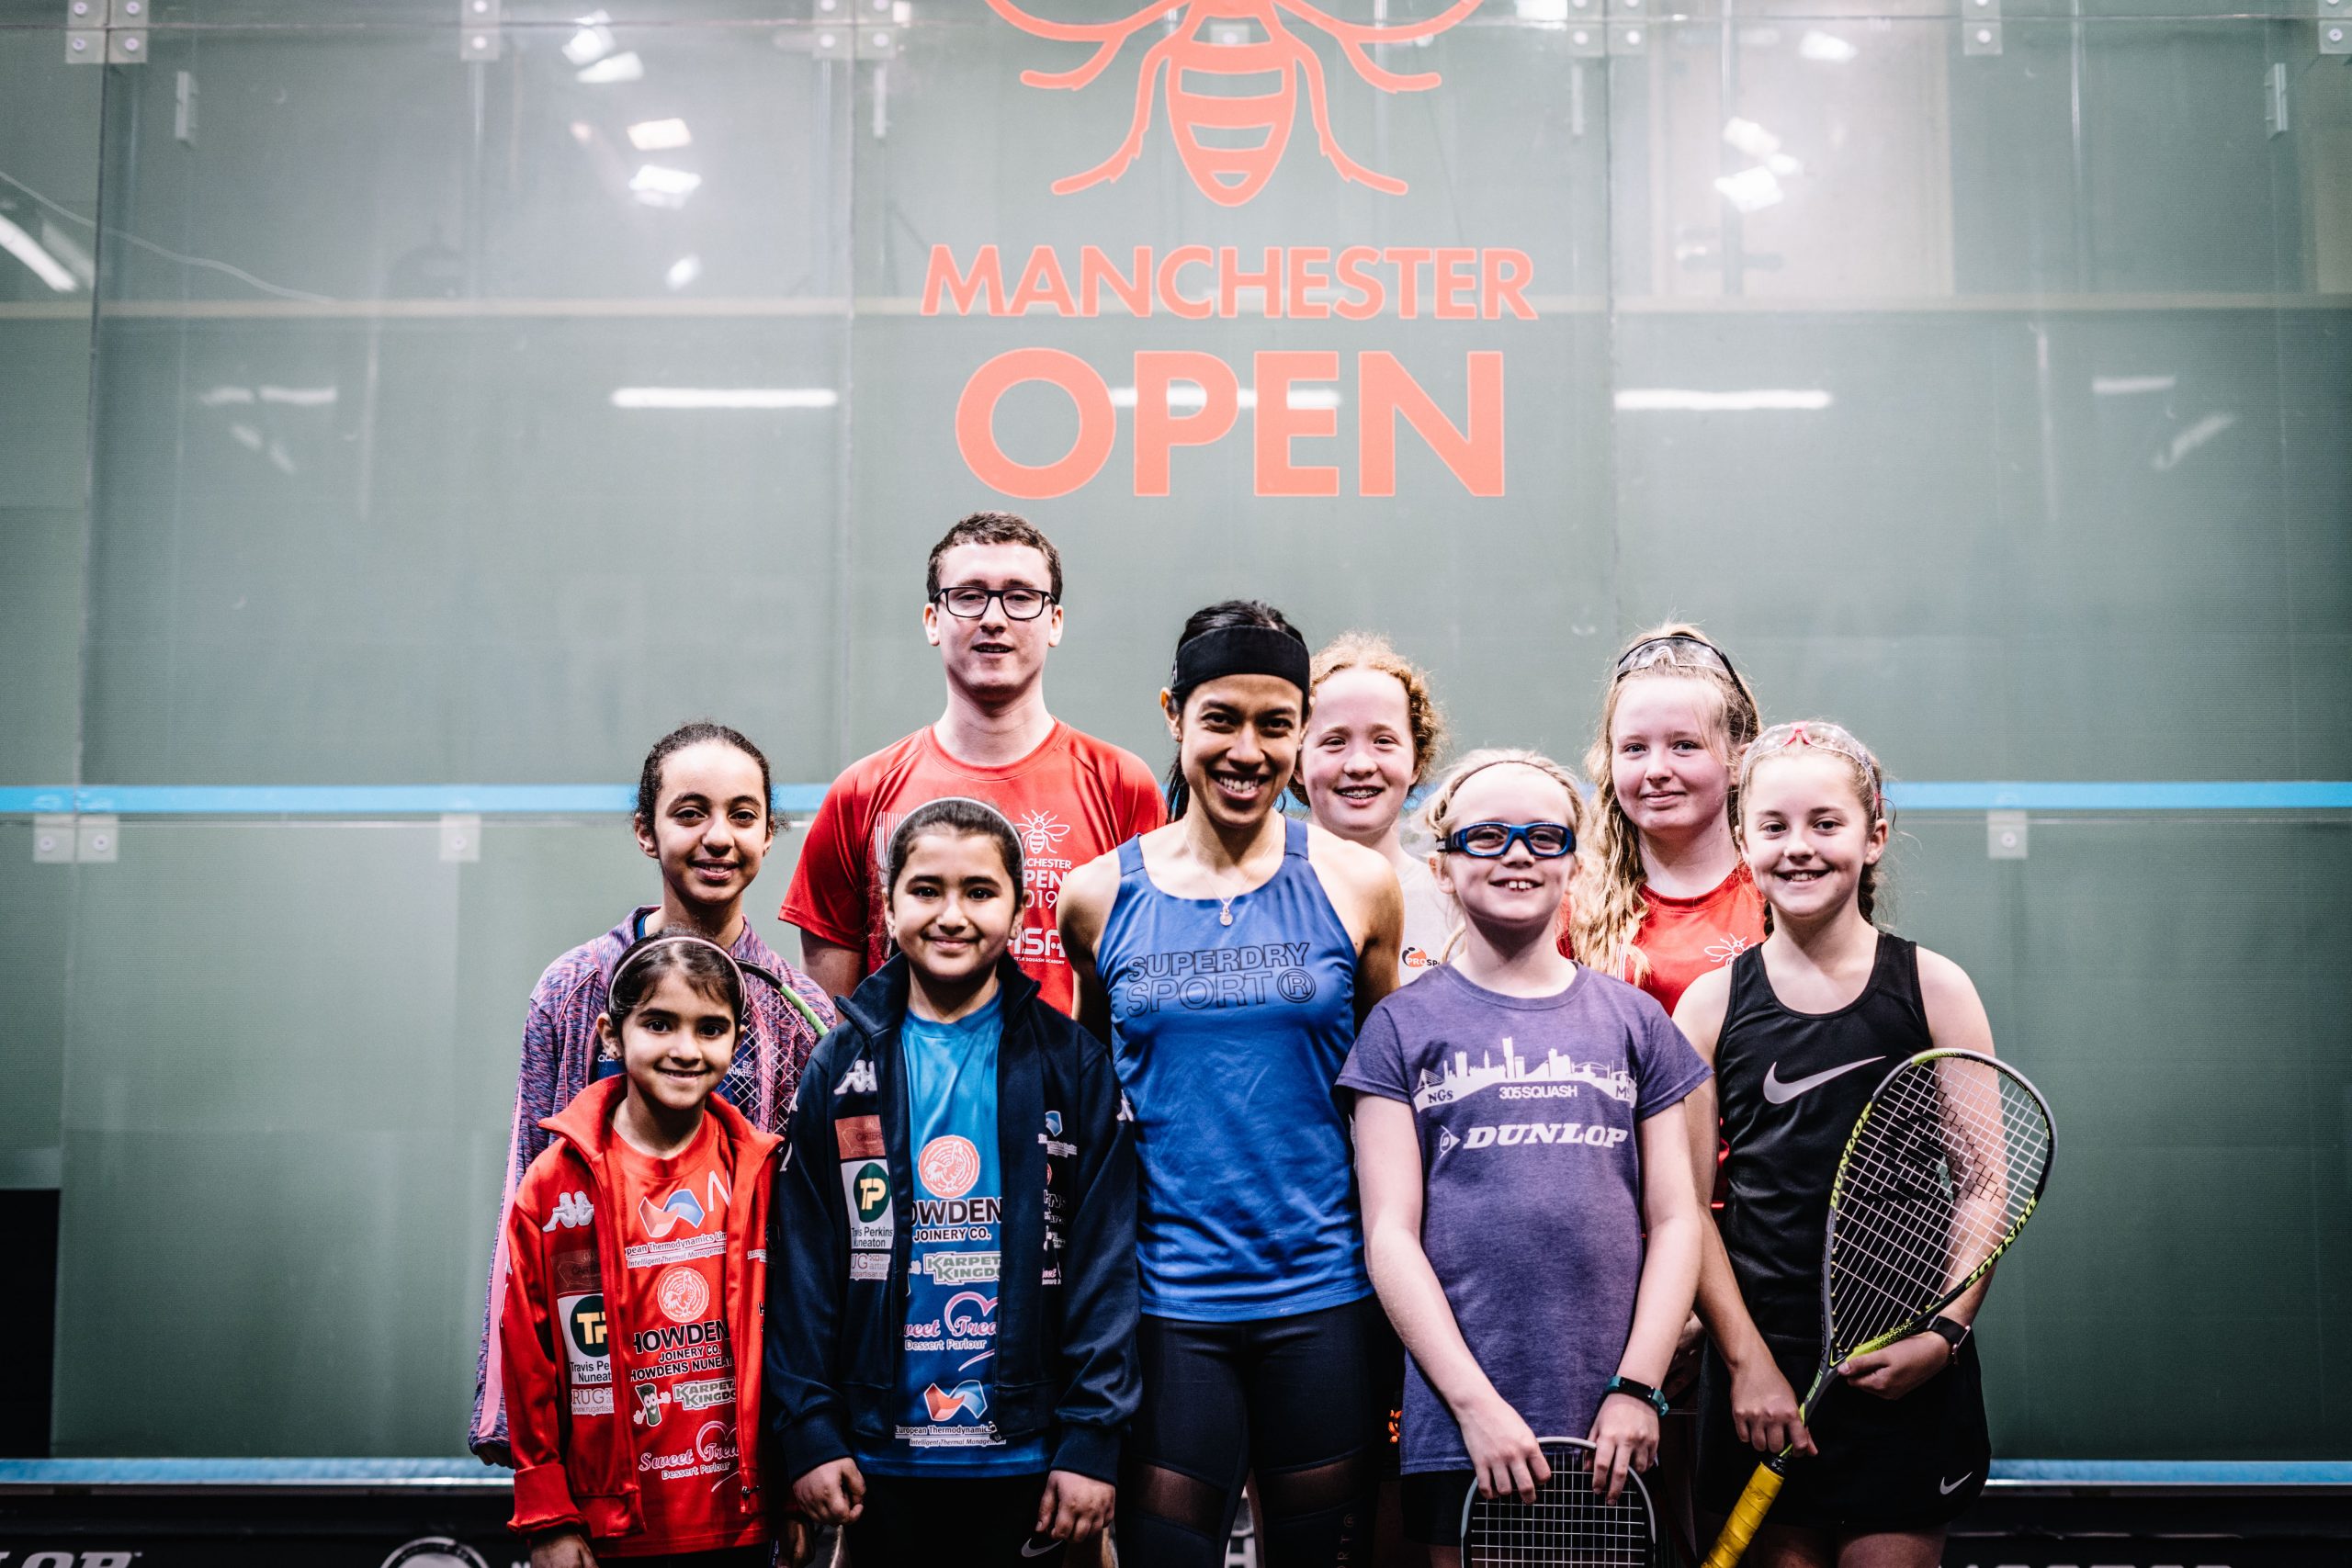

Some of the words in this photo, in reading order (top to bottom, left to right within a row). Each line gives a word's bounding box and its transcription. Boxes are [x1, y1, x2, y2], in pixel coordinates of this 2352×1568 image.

[920, 243, 1540, 321] MANCHESTER
[955, 346, 1505, 500] OPEN
[1024, 858, 1072, 870] CHESTER
[1023, 869, 1068, 888] PEN
[1025, 889, 1058, 909] 019
[1126, 942, 1310, 983] SUPERDRY
[1126, 971, 1272, 1018] SPORT
[1498, 1085, 1577, 1100] 305SQUASH
[1463, 1122, 1628, 1150] DUNLOP
[911, 1198, 1003, 1225] WDEN
[864, 1226, 893, 1237] Perkins
[913, 1228, 967, 1242] JOINERY
[969, 1227, 990, 1239] CO.
[648, 1234, 714, 1251] Thermodynamics
[628, 1258, 662, 1268] Intelligent
[687, 1247, 727, 1259] Managemen
[927, 1256, 1001, 1269] KARPET
[659, 1347, 704, 1362] JOINERY
[706, 1344, 721, 1355] CO.
[905, 1339, 944, 1350] Dessert
[946, 1338, 987, 1350] Parlour
[570, 1361, 594, 1372] Travis
[692, 1355, 733, 1371] NUNEAT
[578, 1372, 612, 1382] Nuneat
[928, 1425, 992, 1435] Thermodynamic
[639, 1449, 695, 1472] Sweet
[662, 1467, 698, 1480] Dessert
[700, 1461, 730, 1474] Parlour
